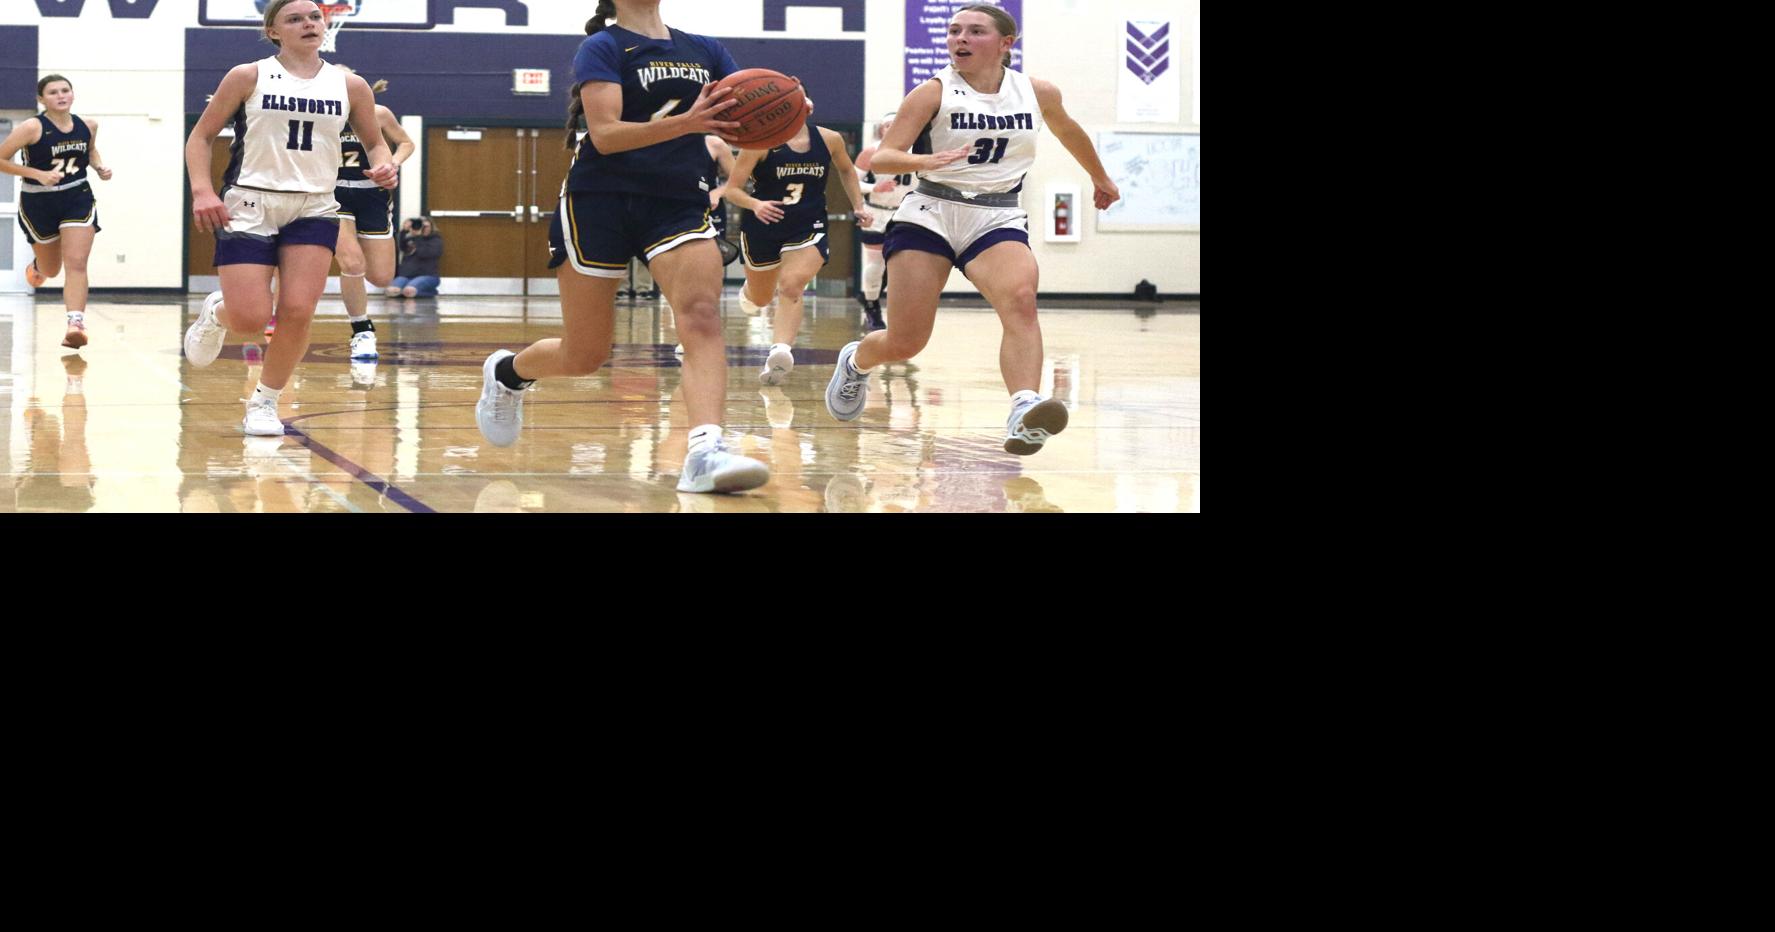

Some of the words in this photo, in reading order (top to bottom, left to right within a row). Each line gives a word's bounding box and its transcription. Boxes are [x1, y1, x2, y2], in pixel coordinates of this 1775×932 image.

[637, 66, 710, 92] WILDCATS
[262, 94, 342, 116] ELLSWORTH
[950, 112, 1033, 130] ELLSWORTH
[286, 119, 314, 151] 11
[51, 142, 87, 157] WILDCATS
[968, 137, 1009, 165] 31
[51, 157, 80, 178] 24
[776, 166, 825, 179] WILDCATS
[783, 183, 804, 205] 3
